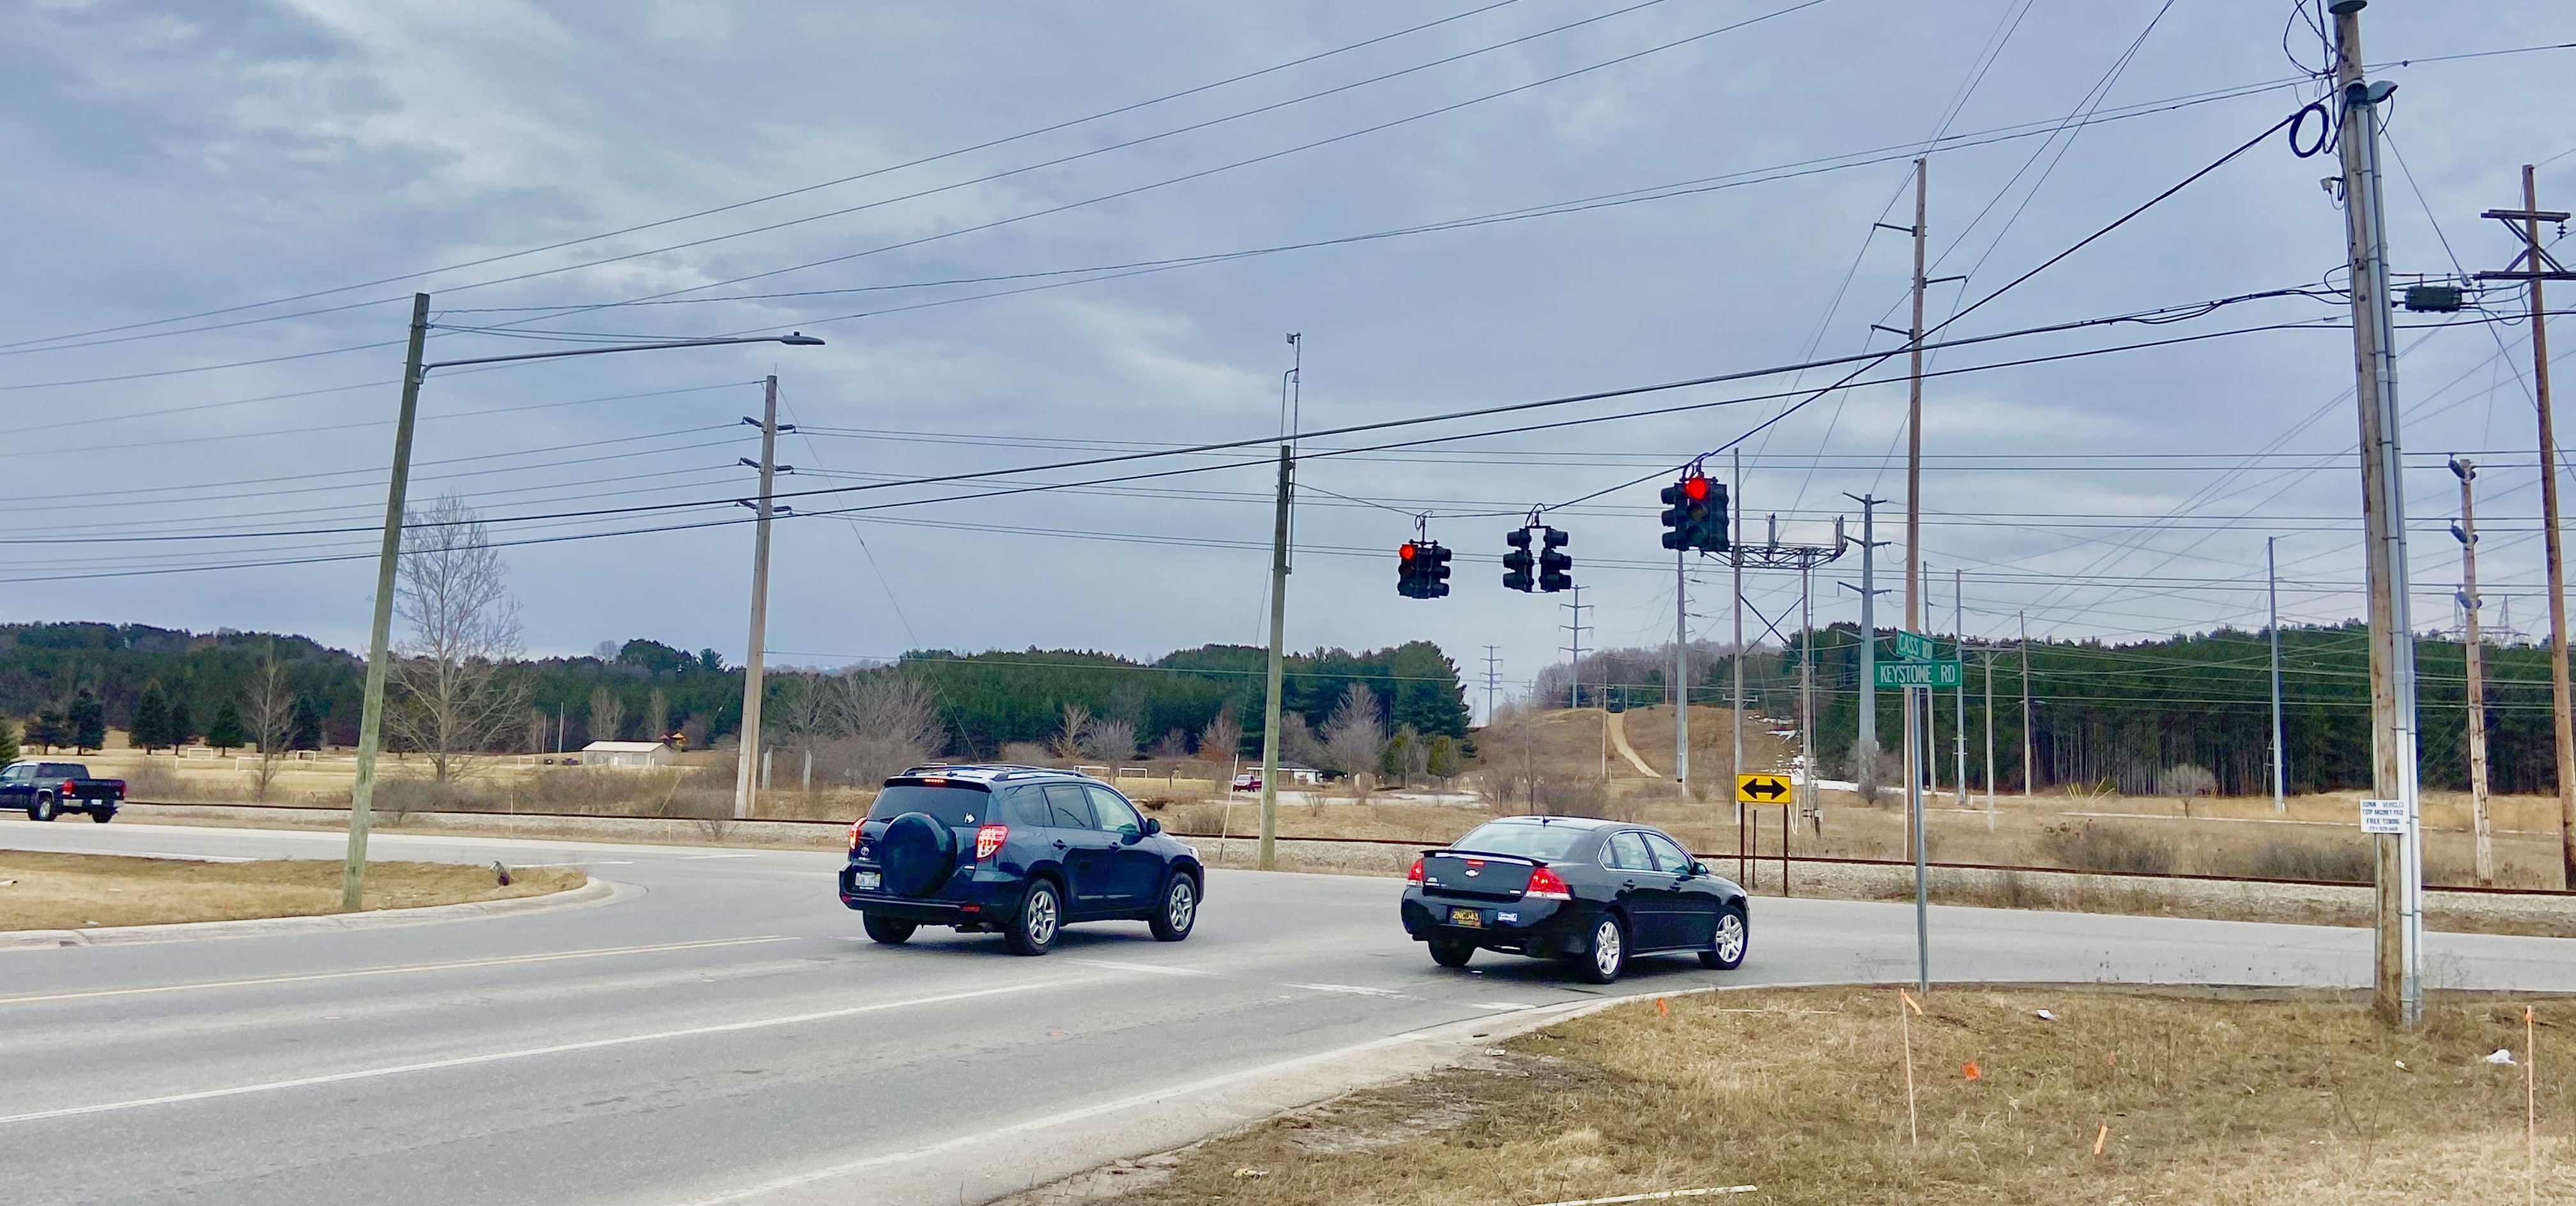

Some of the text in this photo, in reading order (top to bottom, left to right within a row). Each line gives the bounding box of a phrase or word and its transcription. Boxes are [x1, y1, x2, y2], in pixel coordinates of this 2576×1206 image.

[1898, 633, 1933, 660] CASS RD
[1880, 664, 1956, 683] KEYSTONE RD
